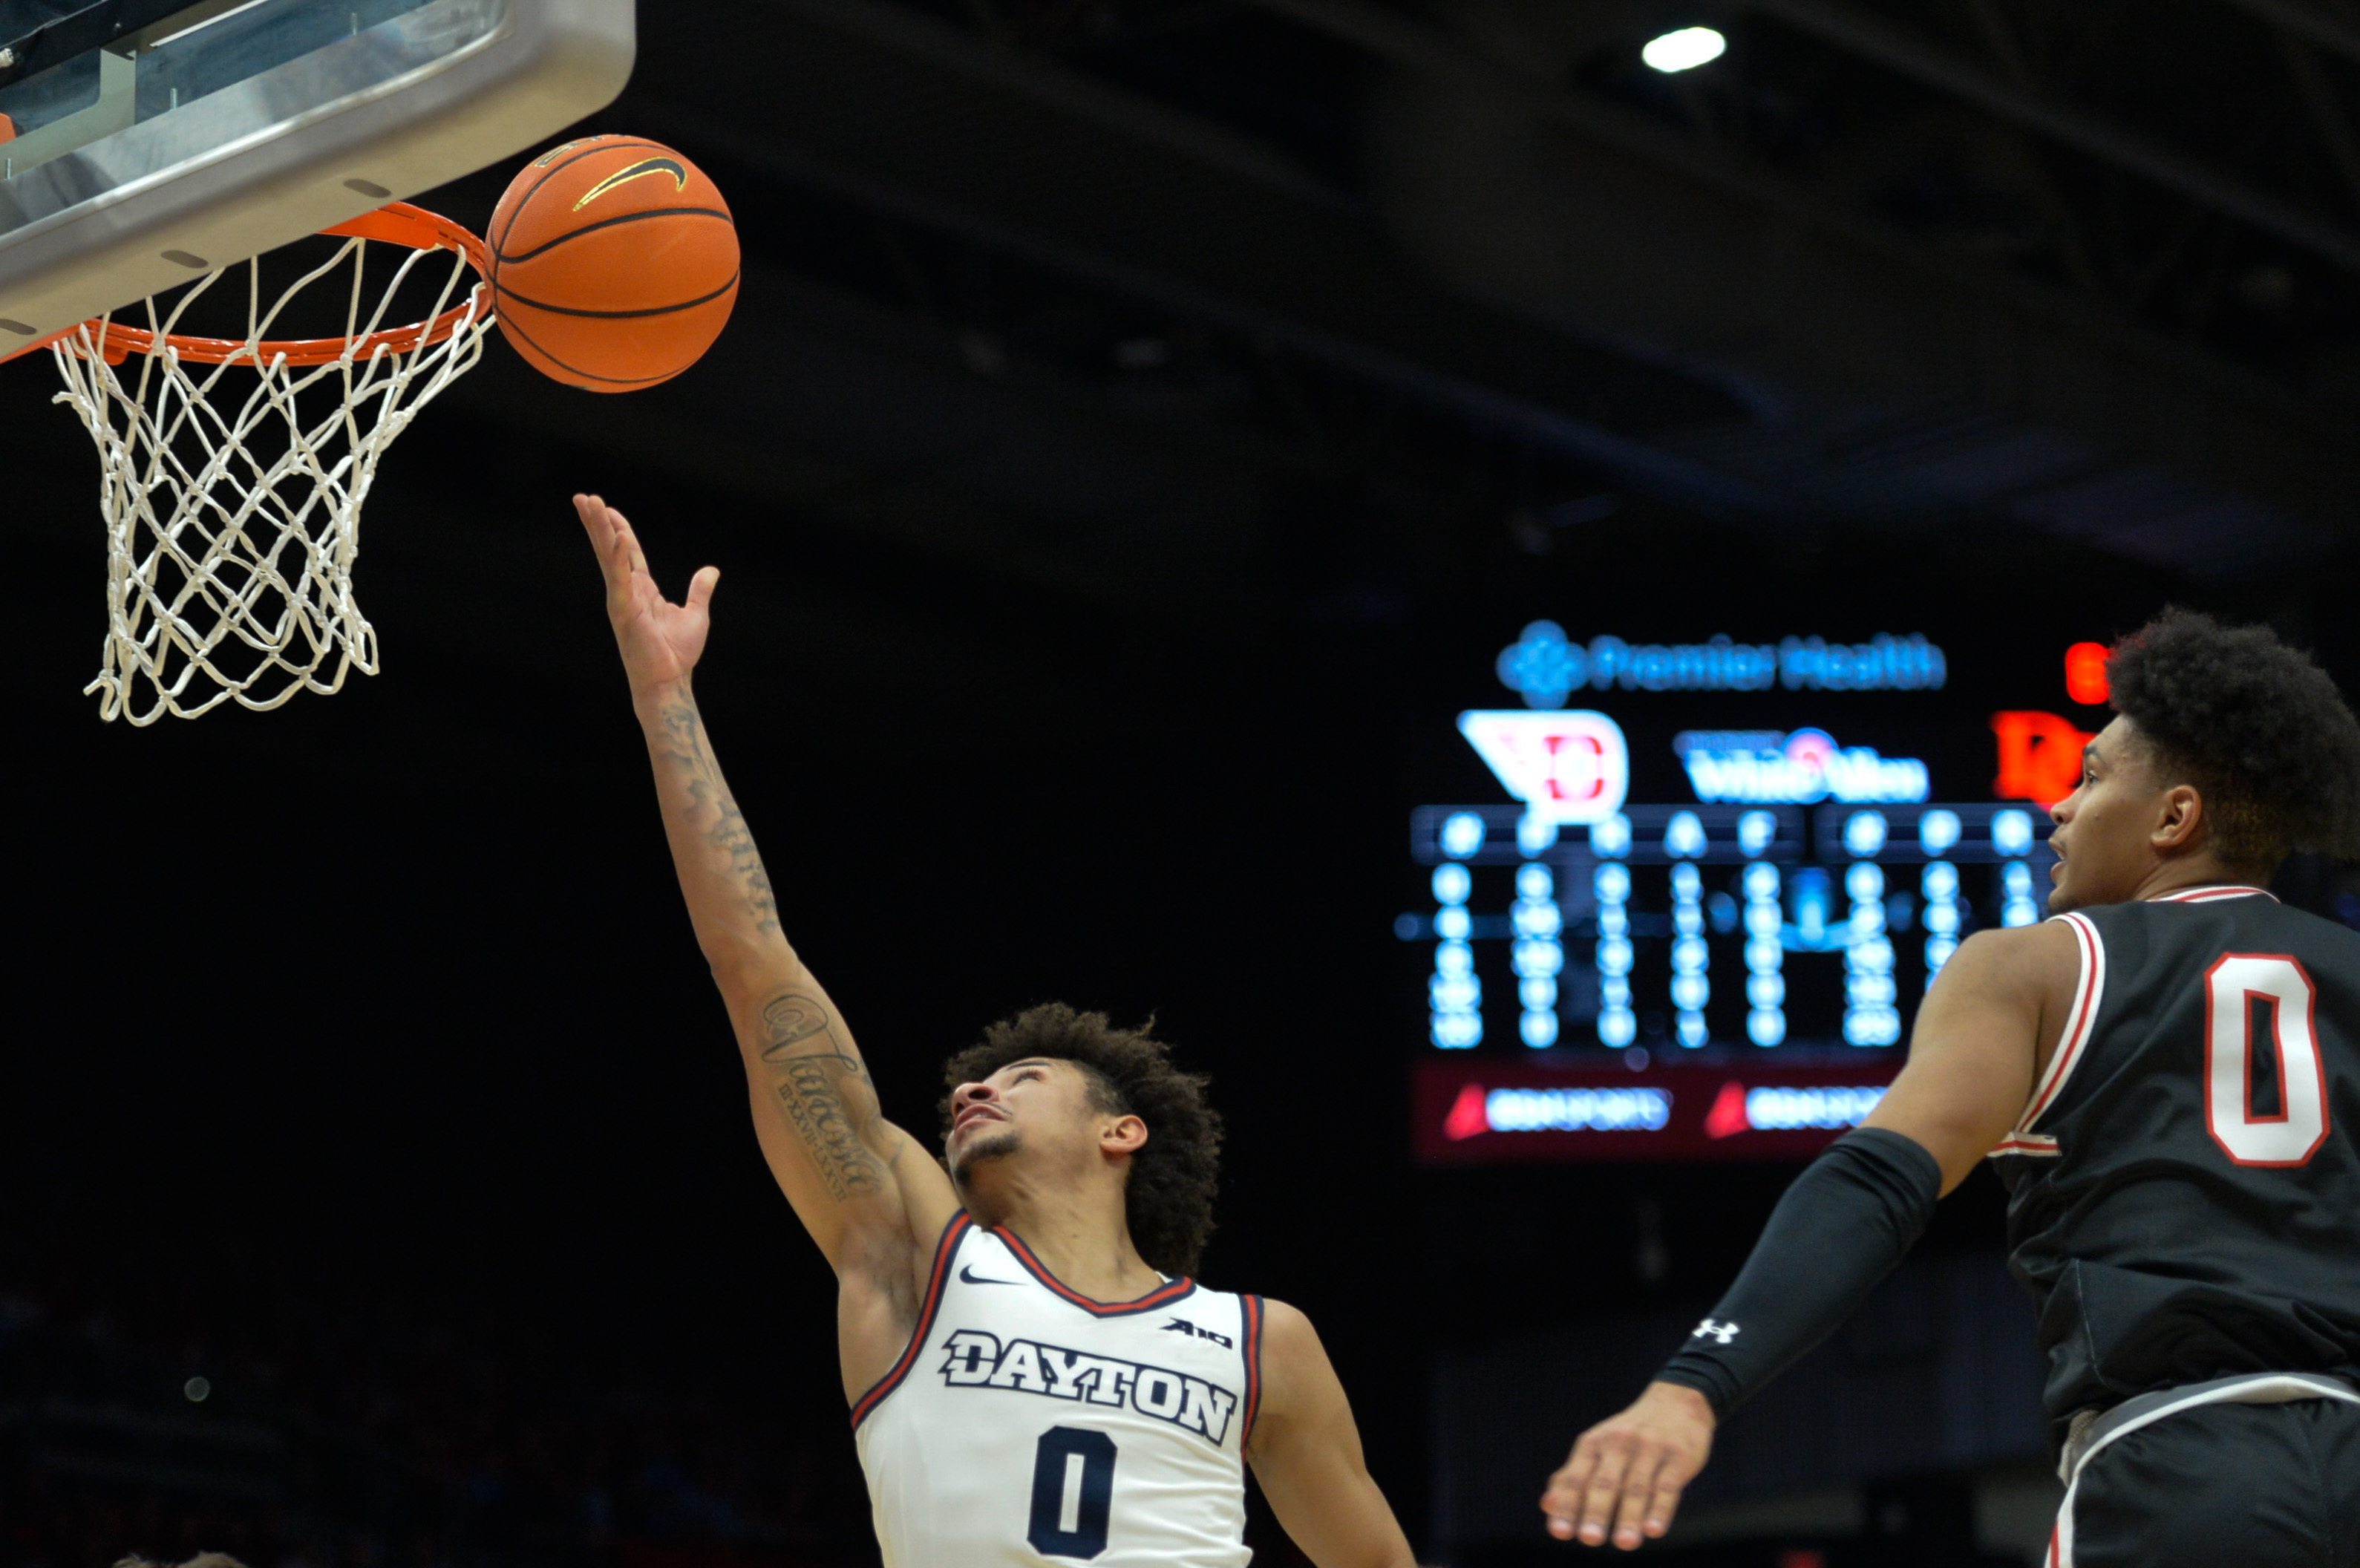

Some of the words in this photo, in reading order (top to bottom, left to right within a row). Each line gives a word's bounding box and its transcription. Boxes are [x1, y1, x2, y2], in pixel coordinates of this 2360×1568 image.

[2204, 952, 2330, 1168] 0
[938, 1329, 1237, 1447] DAYTON
[1027, 1425, 1118, 1560] 0
